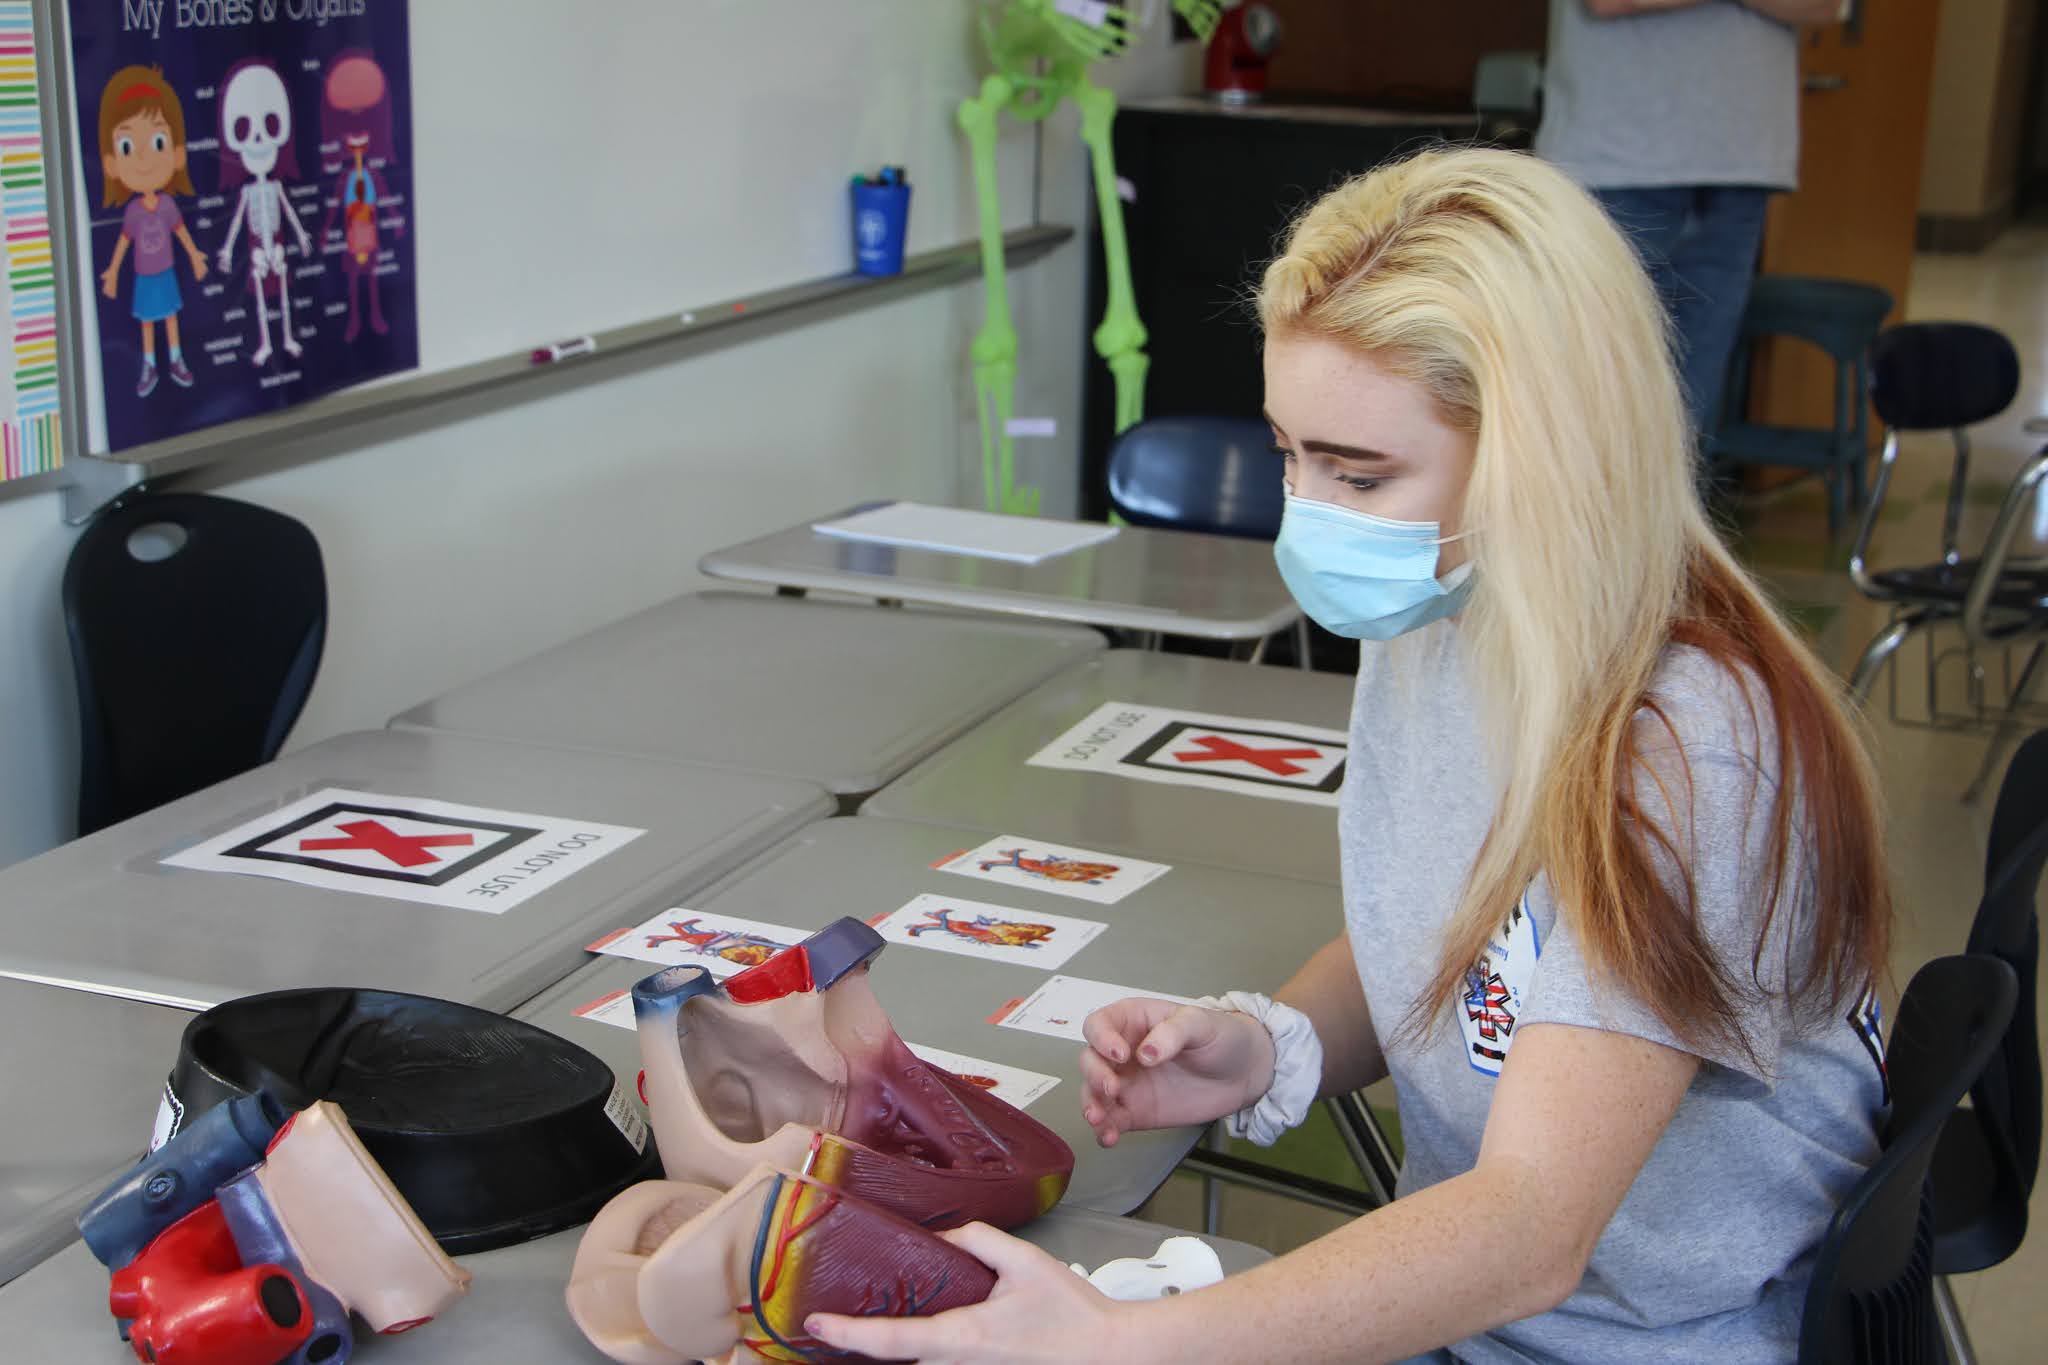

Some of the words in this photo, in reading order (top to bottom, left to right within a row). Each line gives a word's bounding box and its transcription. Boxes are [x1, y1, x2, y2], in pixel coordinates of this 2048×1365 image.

[122, 0, 163, 39] My
[175, 0, 252, 28] Bones
[286, 0, 367, 27] Organs
[557, 833, 602, 849] DO
[512, 849, 570, 875] NOT
[467, 874, 526, 899] USE
